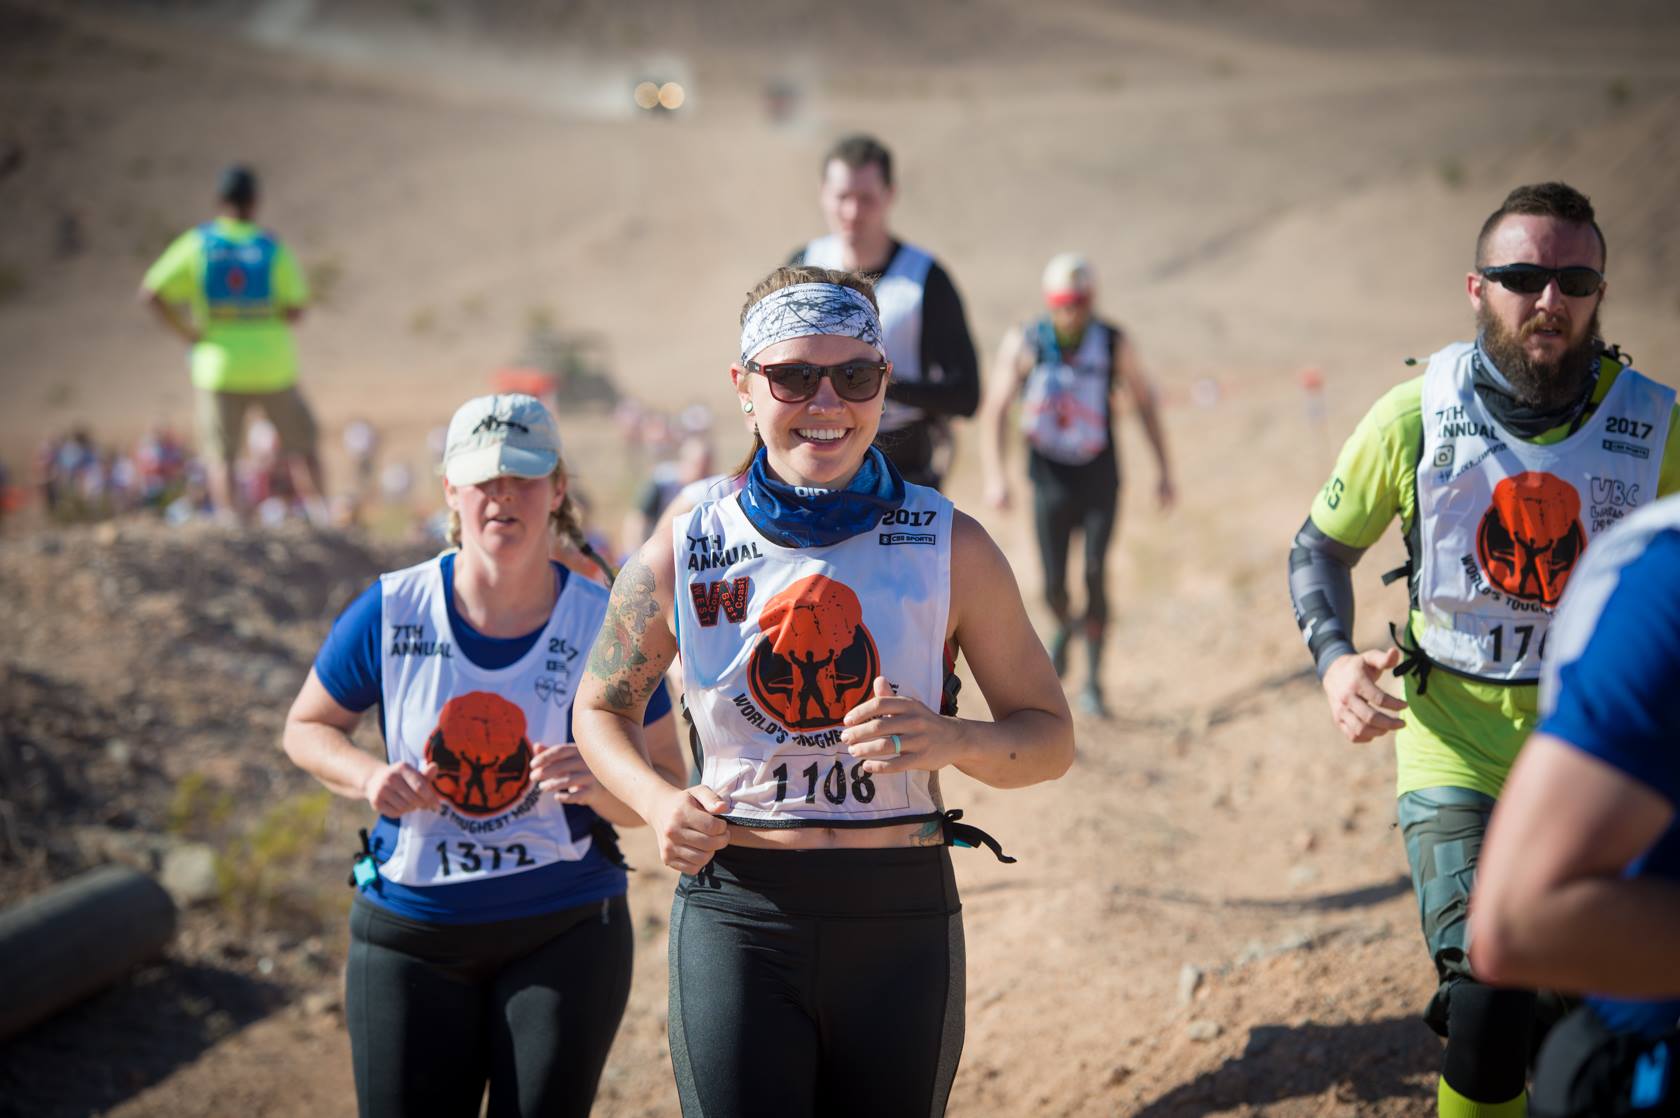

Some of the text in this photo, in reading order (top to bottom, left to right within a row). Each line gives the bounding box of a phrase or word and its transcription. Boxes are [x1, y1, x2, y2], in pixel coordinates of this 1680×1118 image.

[1435, 404, 1465, 425] 7TH
[1438, 421, 1500, 441] NNUAL
[1605, 416, 1653, 440] 2017
[882, 508, 937, 527] 2017
[686, 534, 722, 553] 7TH
[687, 541, 763, 572] ANNUAL
[392, 624, 424, 640] 7TH
[1489, 624, 1549, 663] 17
[732, 692, 789, 745] WORLD'S
[772, 759, 877, 806] 1108
[435, 840, 536, 877] 1372
